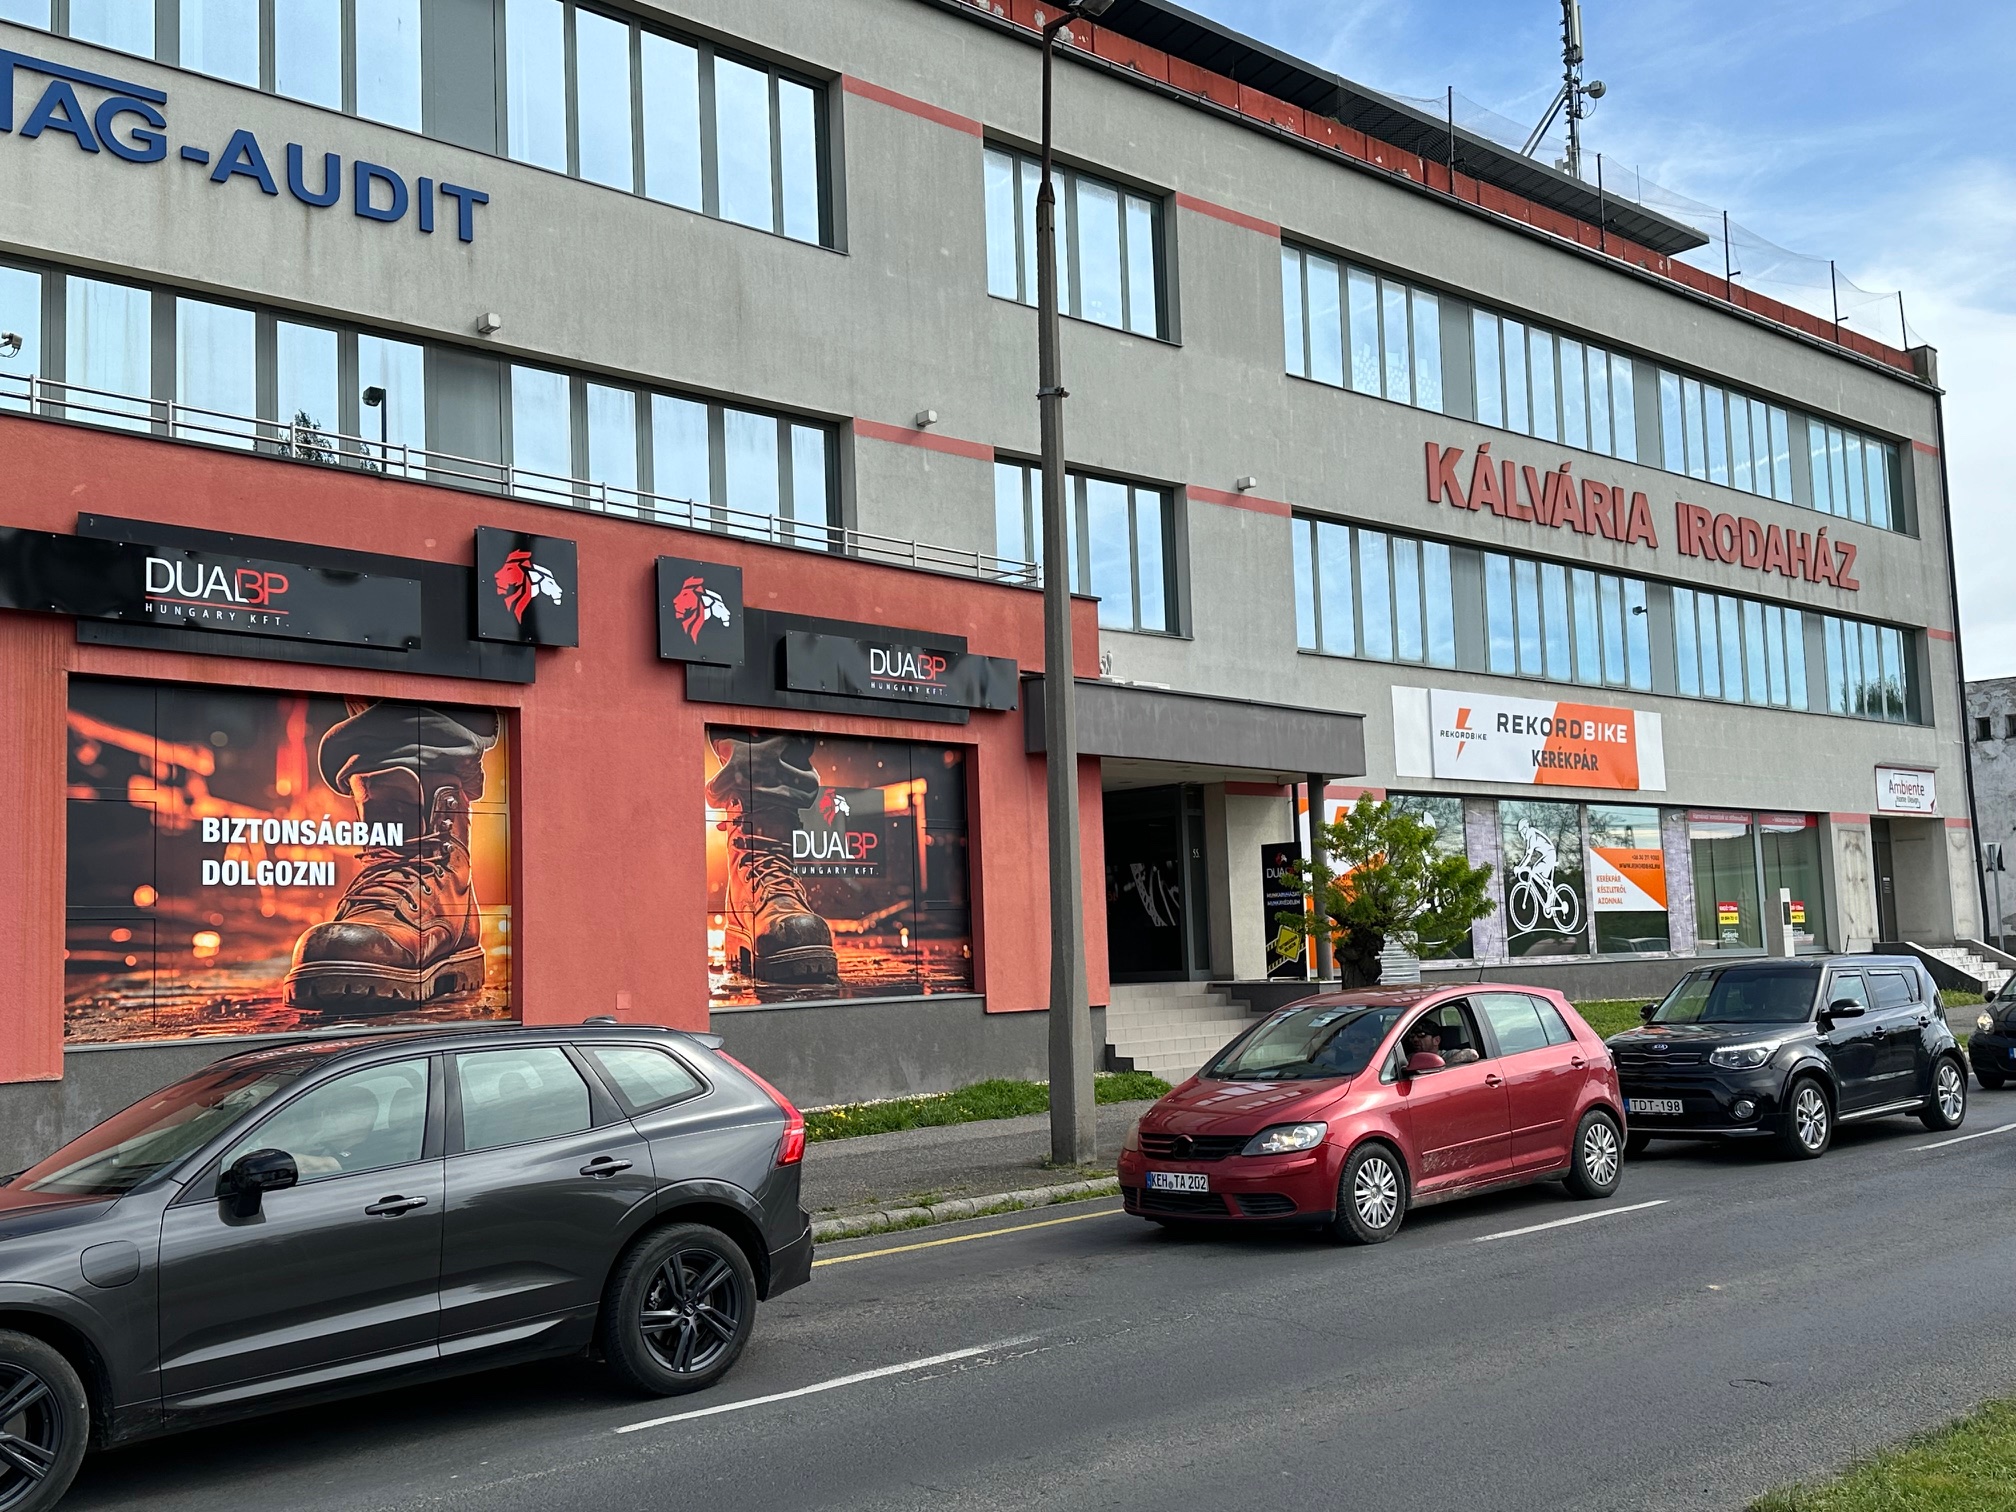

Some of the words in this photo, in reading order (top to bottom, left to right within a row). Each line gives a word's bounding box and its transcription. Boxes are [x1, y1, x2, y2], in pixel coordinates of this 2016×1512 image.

[1425, 441, 1658, 549] KÁLVÁRIA
[1675, 501, 1860, 591] IRODAHÁZ
[145, 603, 236, 621] HUNGARY
[870, 682, 919, 693] HUNGARY
[1440, 729, 1487, 741] REKORDBIKE
[1497, 713, 1627, 743] REKORDBIKE
[1532, 746, 1599, 771] KERÉKPÁR
[1889, 779, 1925, 796] Ambiente
[202, 814, 404, 847] BIZTONSÁGBAN
[202, 860, 335, 887] DOLGOZNI
[793, 866, 847, 875] HUNGARY
[1596, 873, 1621, 882] KERÉKPÁR
[1631, 1100, 1680, 1112] TDT-198
[1151, 1173, 1167, 1188] KEH
[1174, 1175, 1186, 1189] TA
[1188, 1175, 1206, 1190] 202
